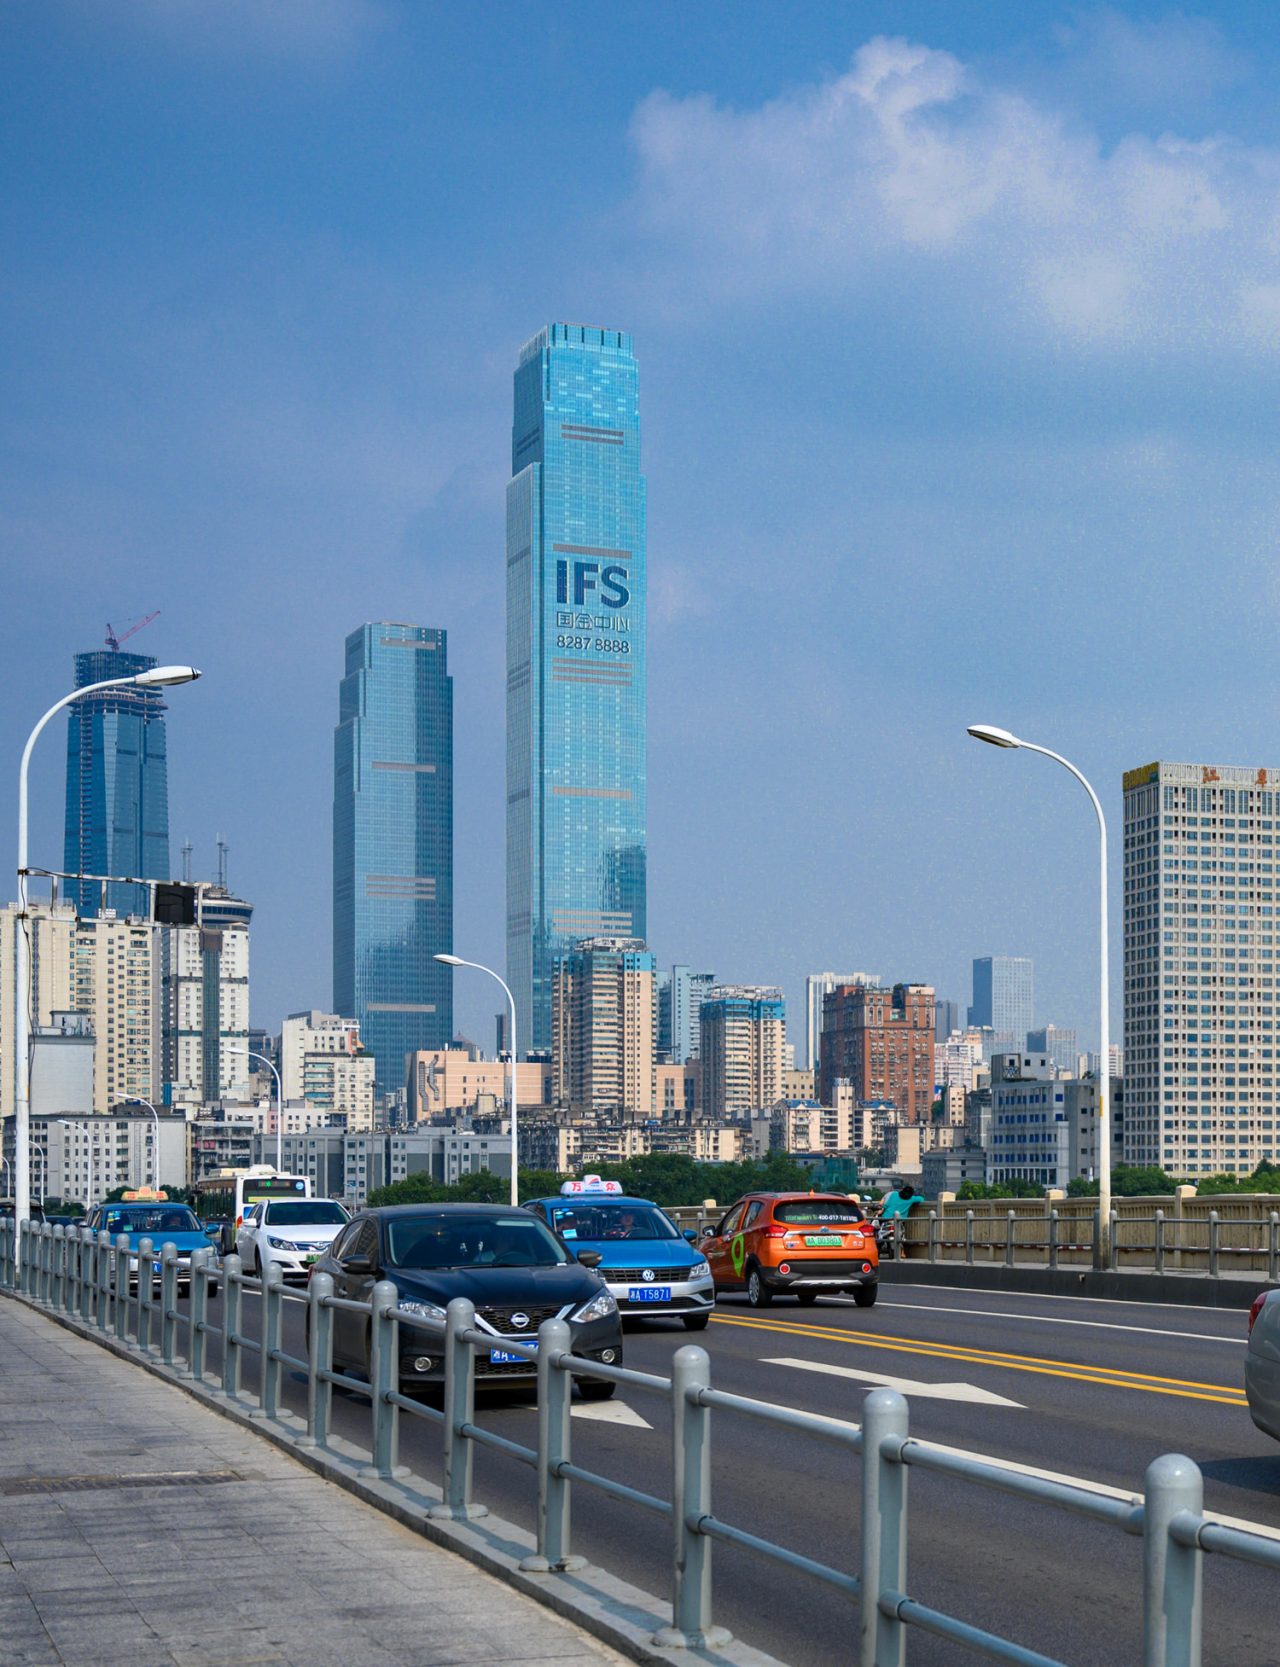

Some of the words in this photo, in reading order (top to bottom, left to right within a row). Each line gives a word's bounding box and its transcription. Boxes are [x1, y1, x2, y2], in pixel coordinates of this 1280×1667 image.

[556, 560, 630, 609] IFS
[556, 611, 630, 634] 国金中心
[556, 635, 592, 650] 8287
[594, 638, 630, 654] 8888
